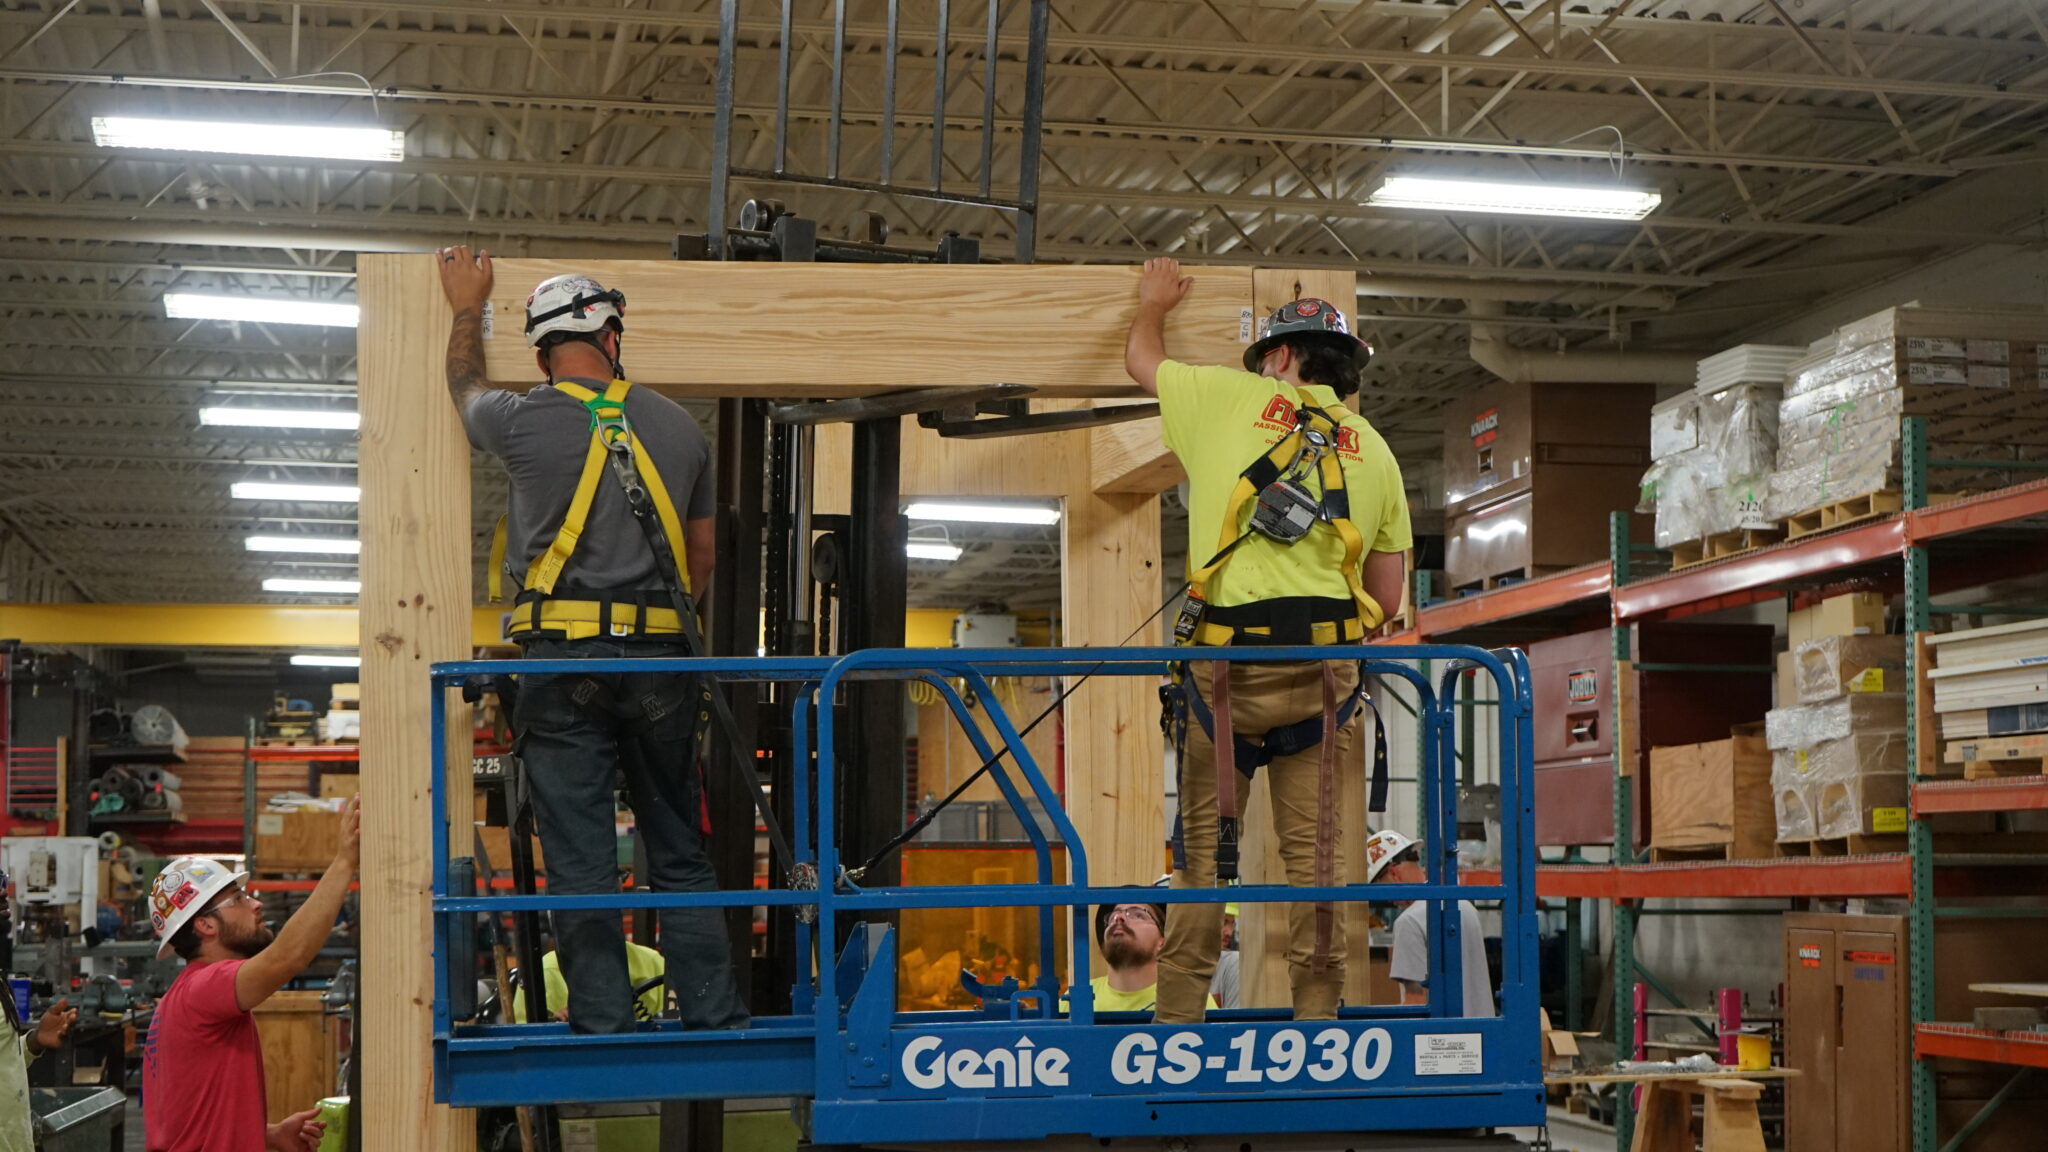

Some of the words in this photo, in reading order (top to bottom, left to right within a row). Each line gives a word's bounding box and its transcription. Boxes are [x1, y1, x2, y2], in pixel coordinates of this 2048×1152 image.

[1471, 413, 1498, 438] KNAACK
[1569, 677, 1596, 698] JOBOX
[486, 758, 501, 774] 25
[901, 1035, 1071, 1089] Genie
[1110, 1027, 1393, 1085] GS-1930
